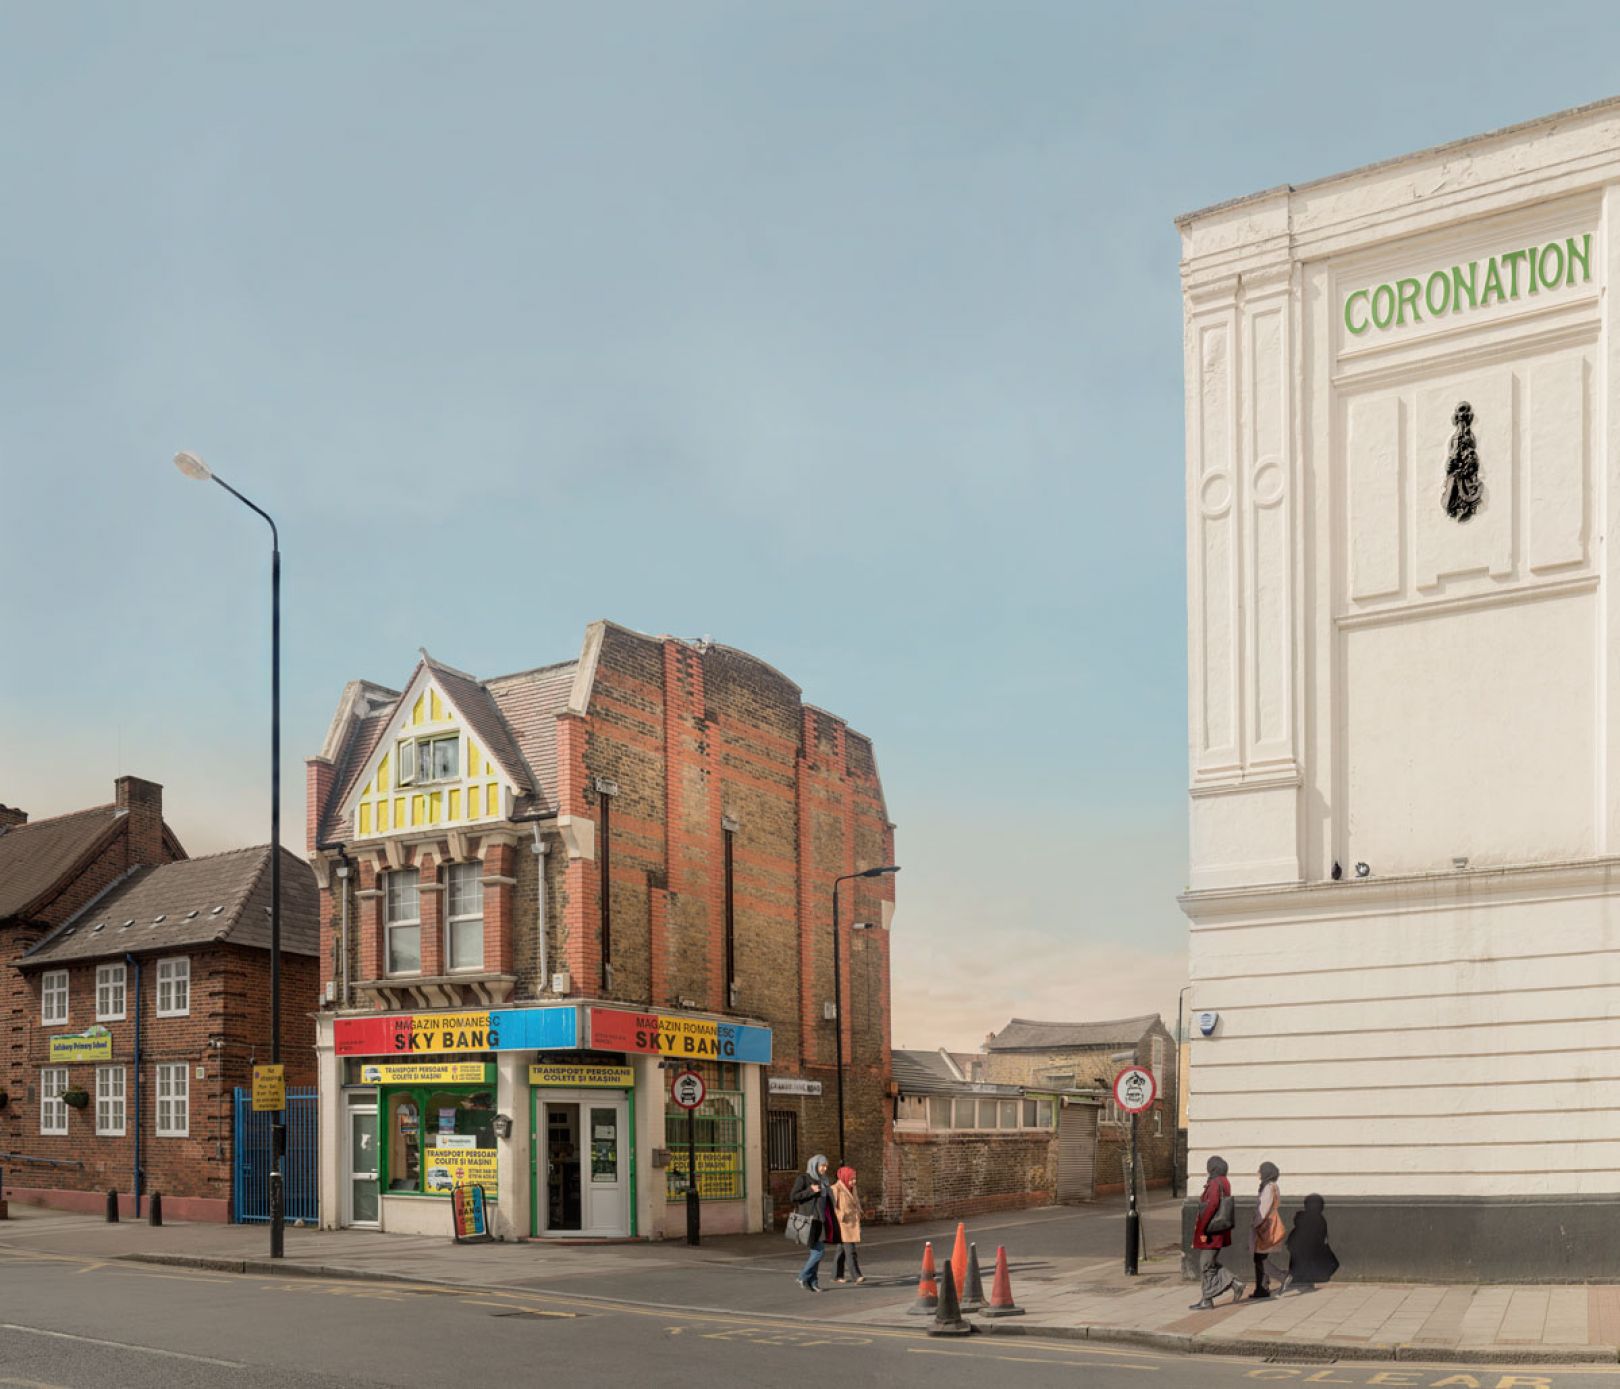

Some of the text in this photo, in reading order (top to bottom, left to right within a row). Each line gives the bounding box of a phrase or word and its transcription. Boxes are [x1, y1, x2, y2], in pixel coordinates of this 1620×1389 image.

[1344, 233, 1592, 335] CORONATION
[395, 1015, 500, 1031] MAGAZIN ROMANESC
[636, 1017, 735, 1039] MAGAZIN ROMANESC
[395, 1030, 499, 1050] SKY BANG
[635, 1031, 676, 1051] SKY
[684, 1035, 735, 1056] BANG
[385, 1066, 418, 1074] TRANSPORT
[533, 1067, 631, 1076] TRANSPORT PERSOANE
[543, 1074, 576, 1082] COLETE
[427, 1149, 464, 1158] TRANSPORT
[434, 1157, 459, 1165] COLETE
[1242, 1368, 1553, 1389] CLEAR
